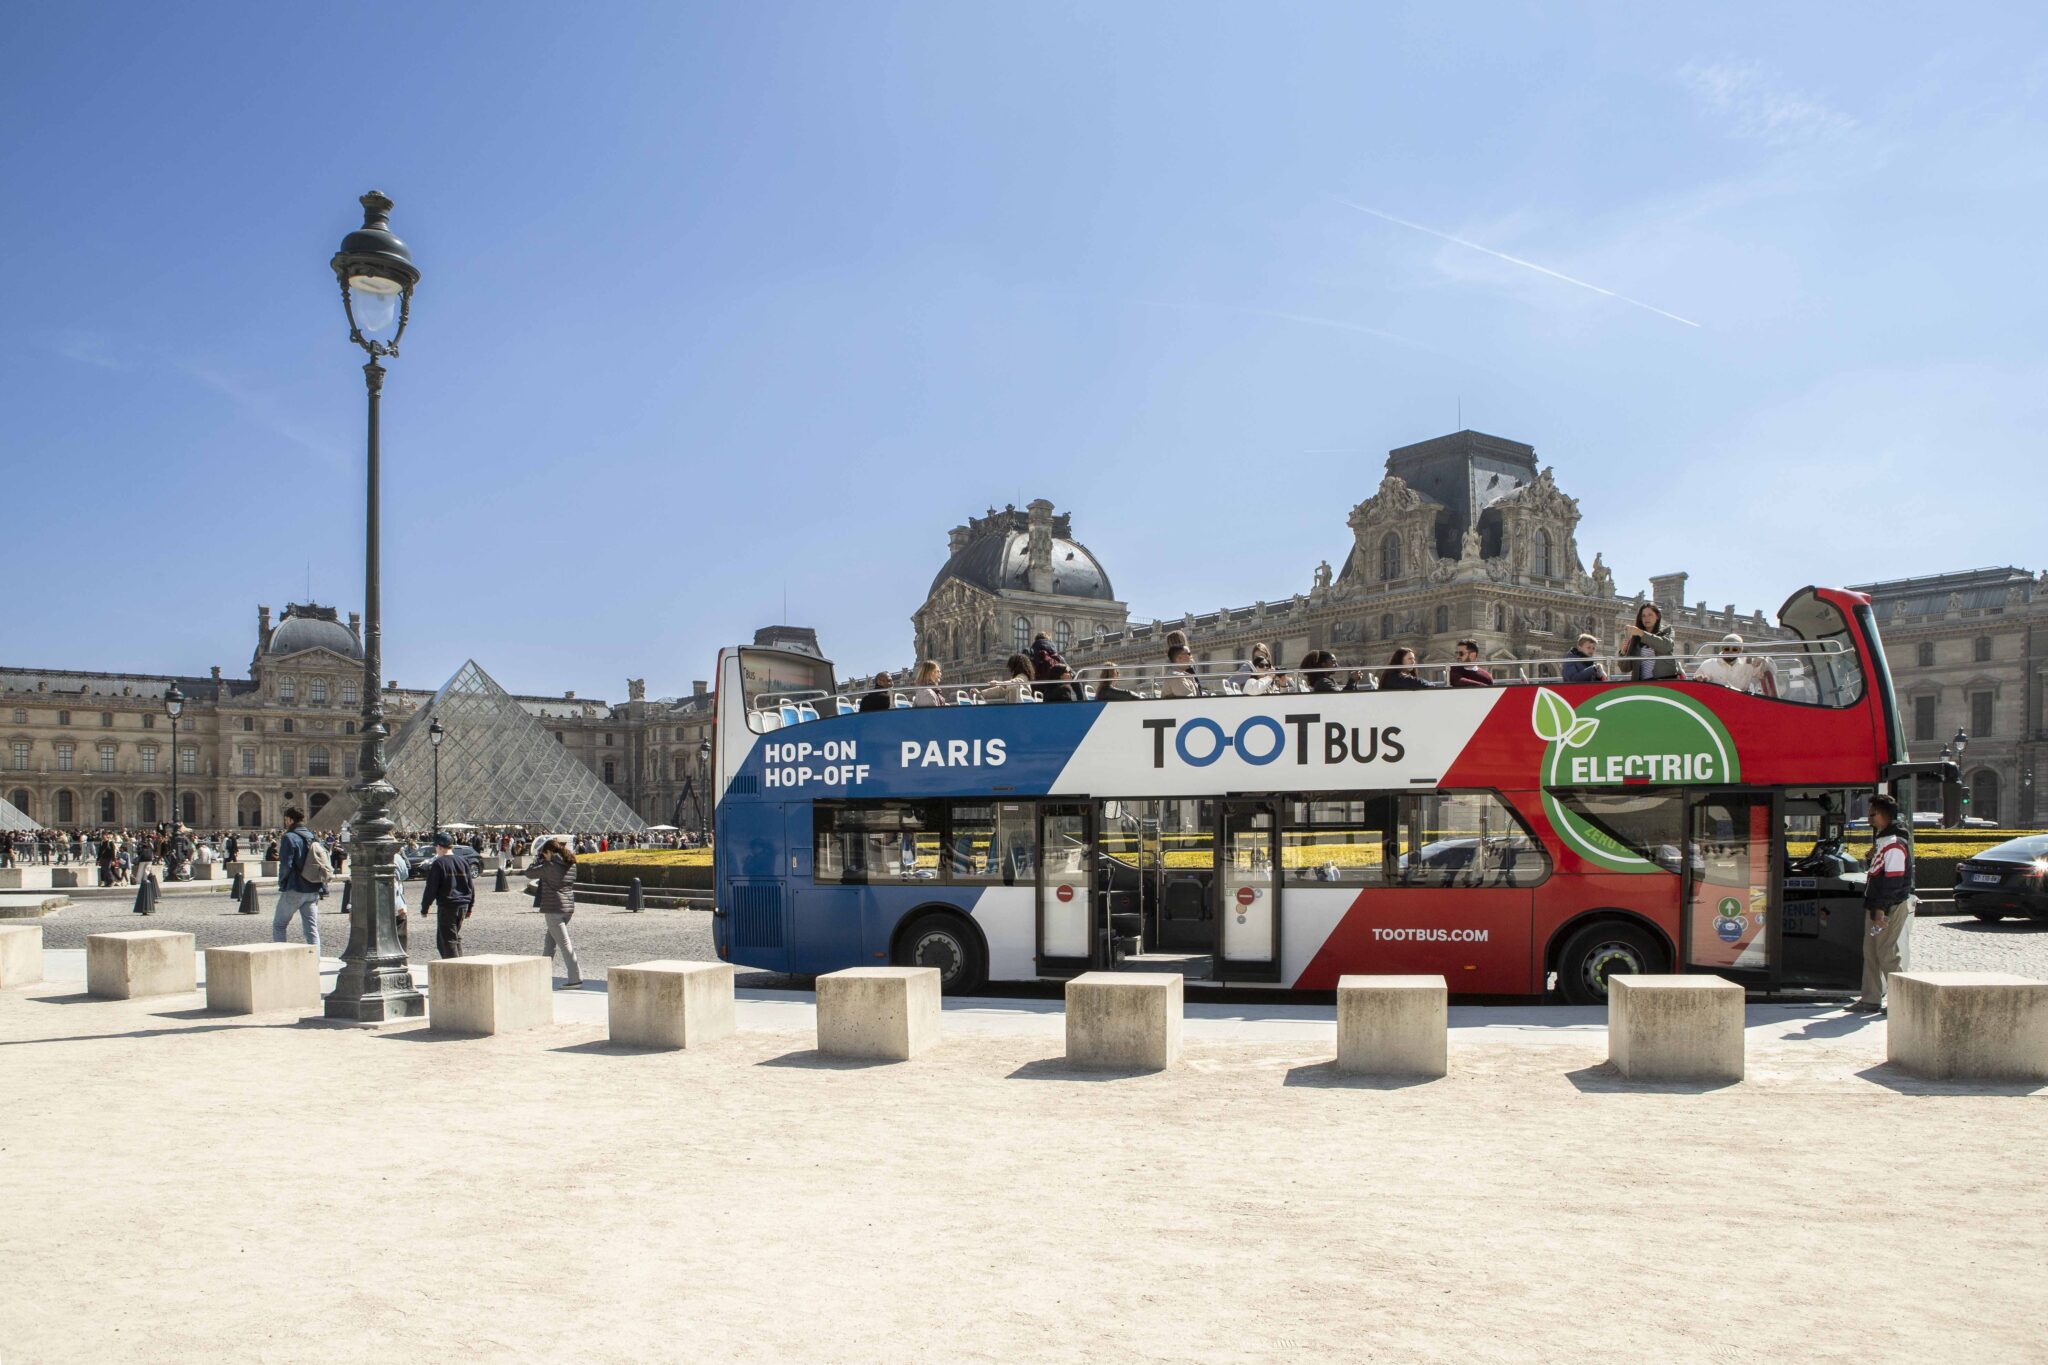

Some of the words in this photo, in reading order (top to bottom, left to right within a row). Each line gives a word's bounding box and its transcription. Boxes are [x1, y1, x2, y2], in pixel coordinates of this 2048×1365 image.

[765, 740, 857, 763] HOP-ON
[901, 738, 1007, 767] PARIS
[765, 765, 870, 788] HOP-OFF
[1571, 752, 1713, 783] ELECTRIC
[1372, 928, 1489, 942] TOOTBUS.COM
